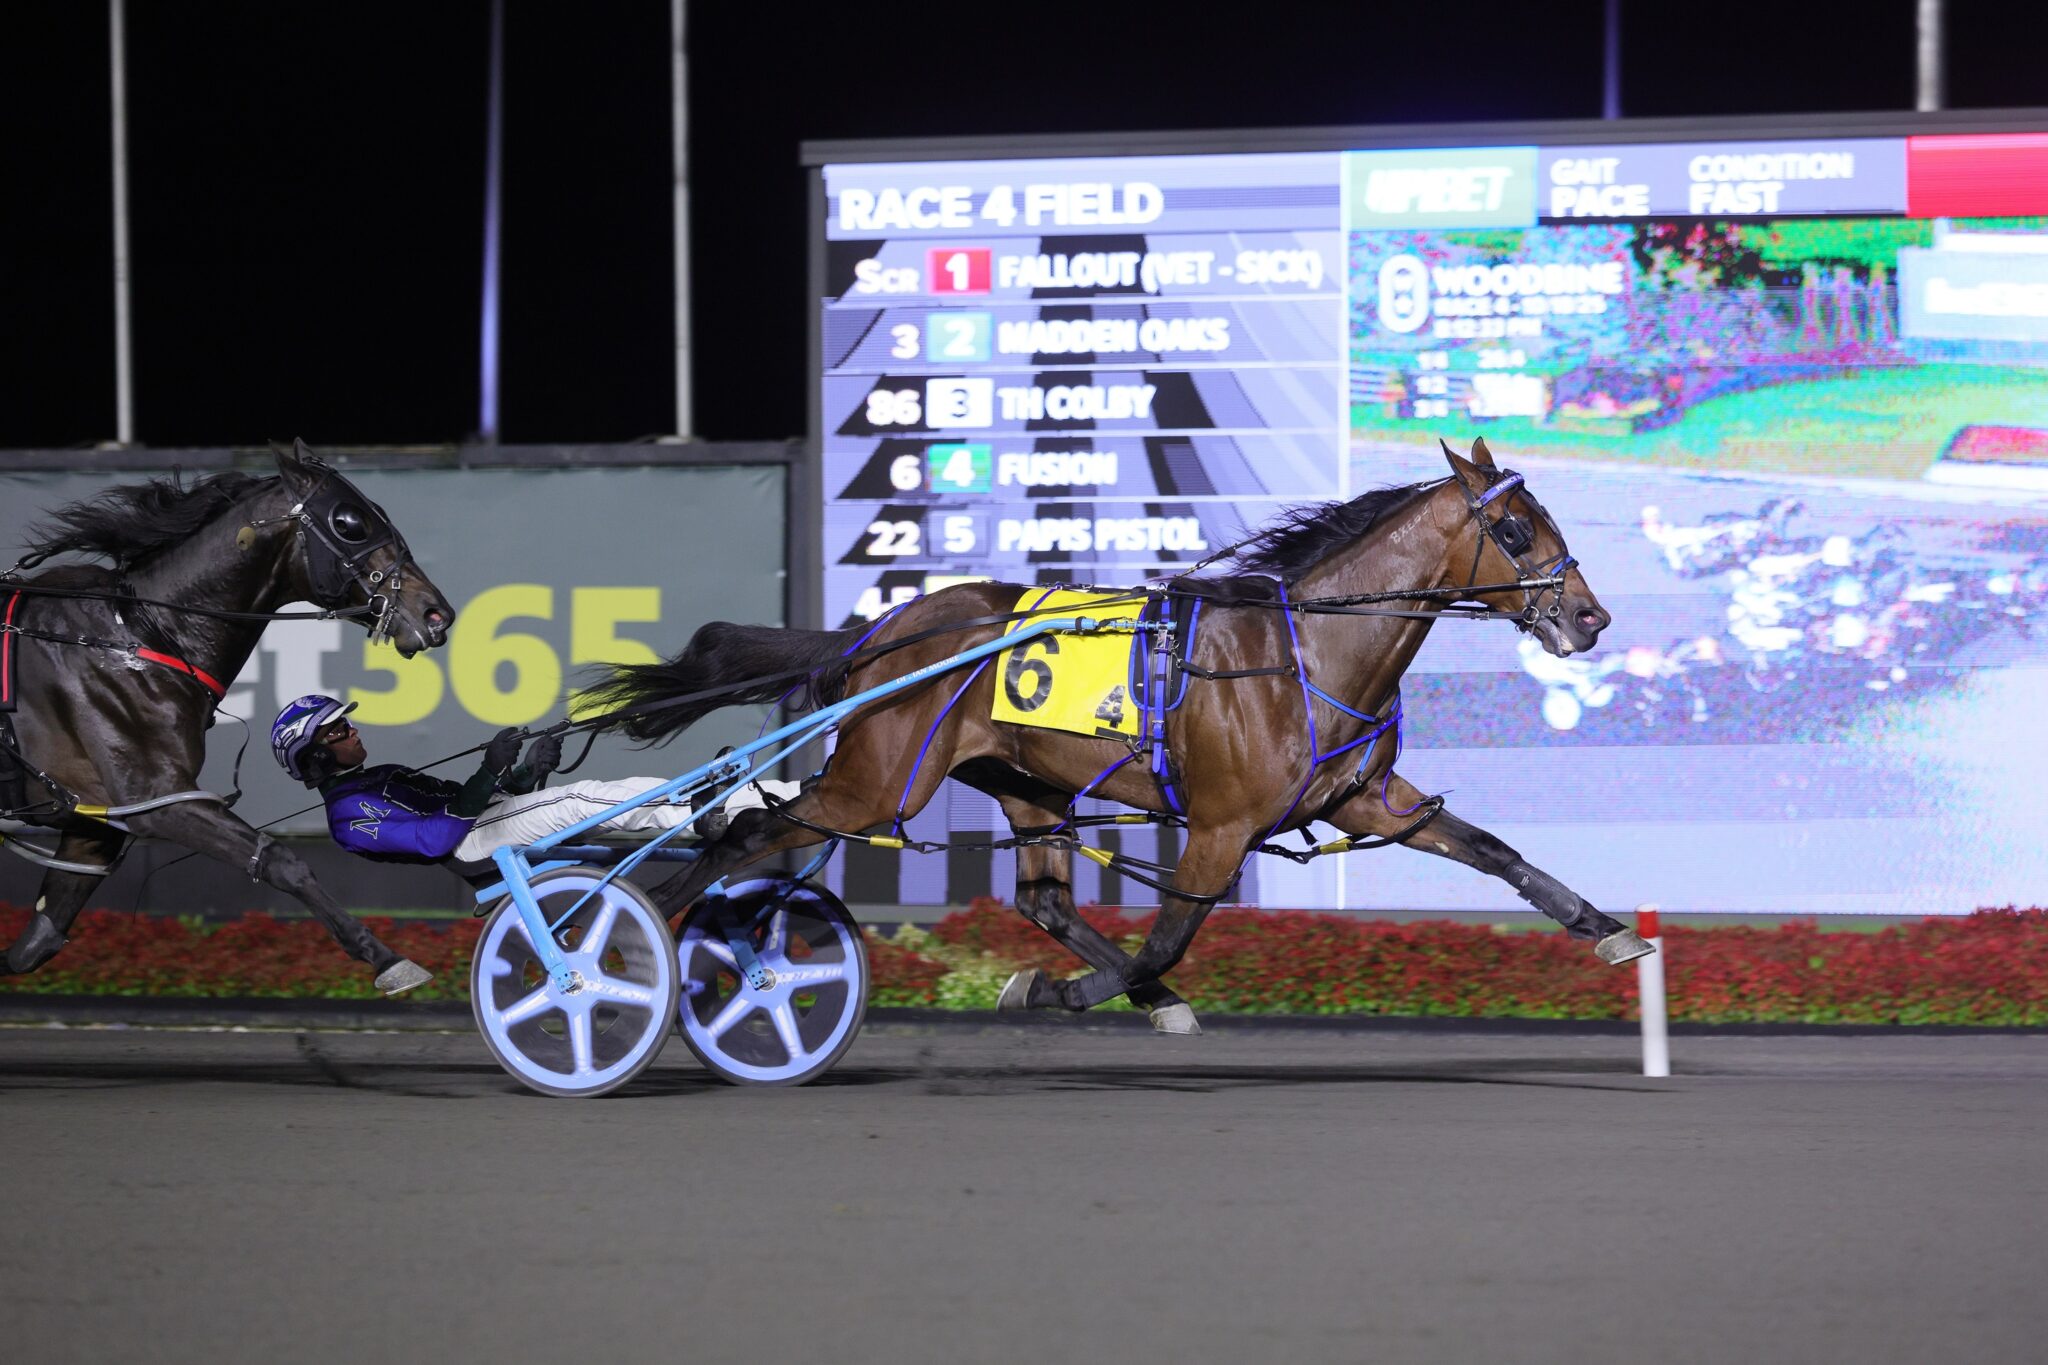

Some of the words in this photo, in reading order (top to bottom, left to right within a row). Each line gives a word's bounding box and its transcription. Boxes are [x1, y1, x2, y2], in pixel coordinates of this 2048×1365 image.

[1549, 157, 1620, 186] GAIT
[1688, 152, 1854, 182] CONDITION
[838, 187, 974, 229] RACE
[980, 186, 1017, 226] 4
[1025, 182, 1164, 225] FIELD
[1550, 184, 1651, 218] PACE
[1688, 181, 1785, 214] FAST
[944, 253, 970, 291] 1
[998, 253, 1141, 288] FALLOUT
[891, 323, 920, 359] 3
[943, 320, 976, 357] 2
[998, 319, 1138, 354] MADDEN
[1138, 318, 1231, 352] OAKS
[866, 388, 921, 424] 86
[949, 386, 972, 418] 3
[997, 386, 1045, 420] TH
[1044, 385, 1157, 418] COLBY
[890, 456, 921, 490] 6
[941, 449, 976, 488] 4
[998, 452, 1118, 486] FUSION
[867, 521, 921, 556] 22
[943, 516, 976, 553] 5
[1095, 517, 1208, 551] PISTOL
[928, 654, 960, 672] MOORE
[1005, 632, 1059, 712] 6
[1095, 684, 1126, 728] 4
[350, 800, 391, 840] M
